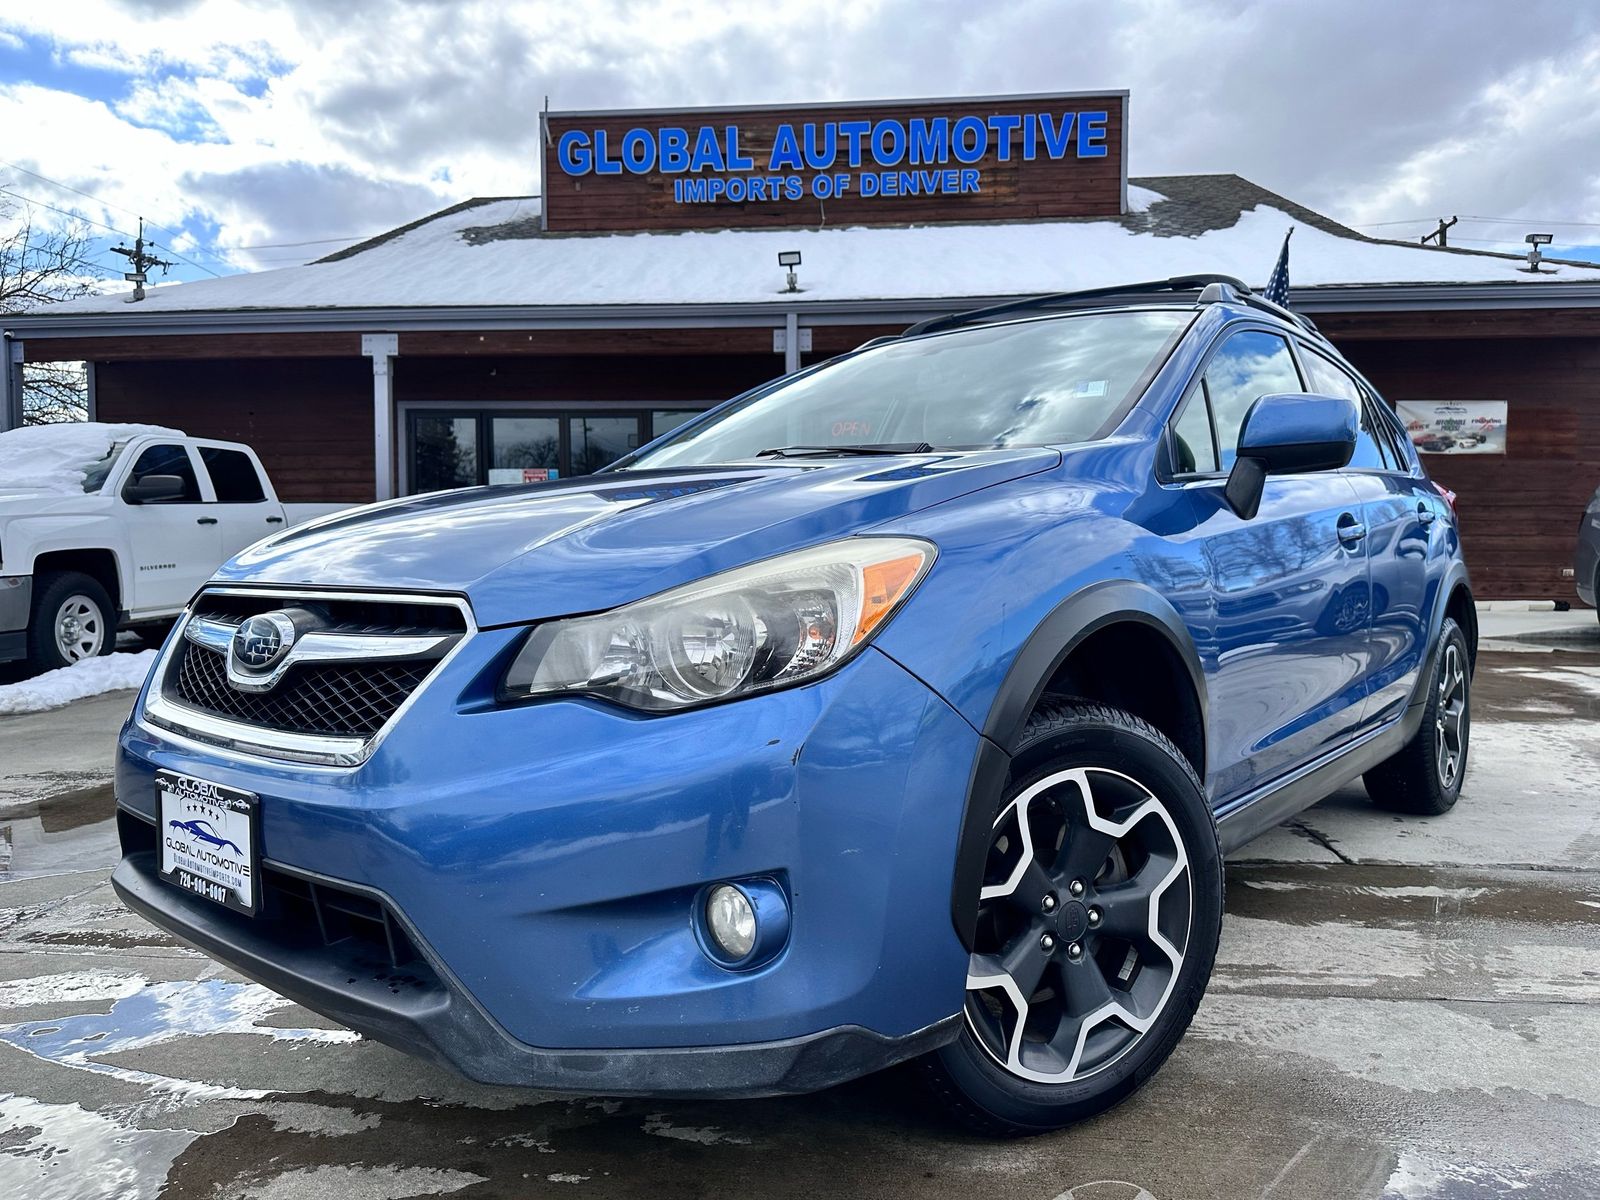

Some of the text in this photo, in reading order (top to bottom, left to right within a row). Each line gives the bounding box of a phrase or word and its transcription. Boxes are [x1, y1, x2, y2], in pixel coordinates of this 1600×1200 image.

[557, 111, 1108, 176] GLOBAL AUTOMOTIVE
[674, 169, 980, 204] IMPORTS OF DENVER
[831, 421, 872, 437] OPEN
[174, 788, 225, 808] AUTOMOTIVE
[177, 777, 224, 801] GLOBAL
[165, 837, 250, 877] GLOBAL AUTOMOTIVE
